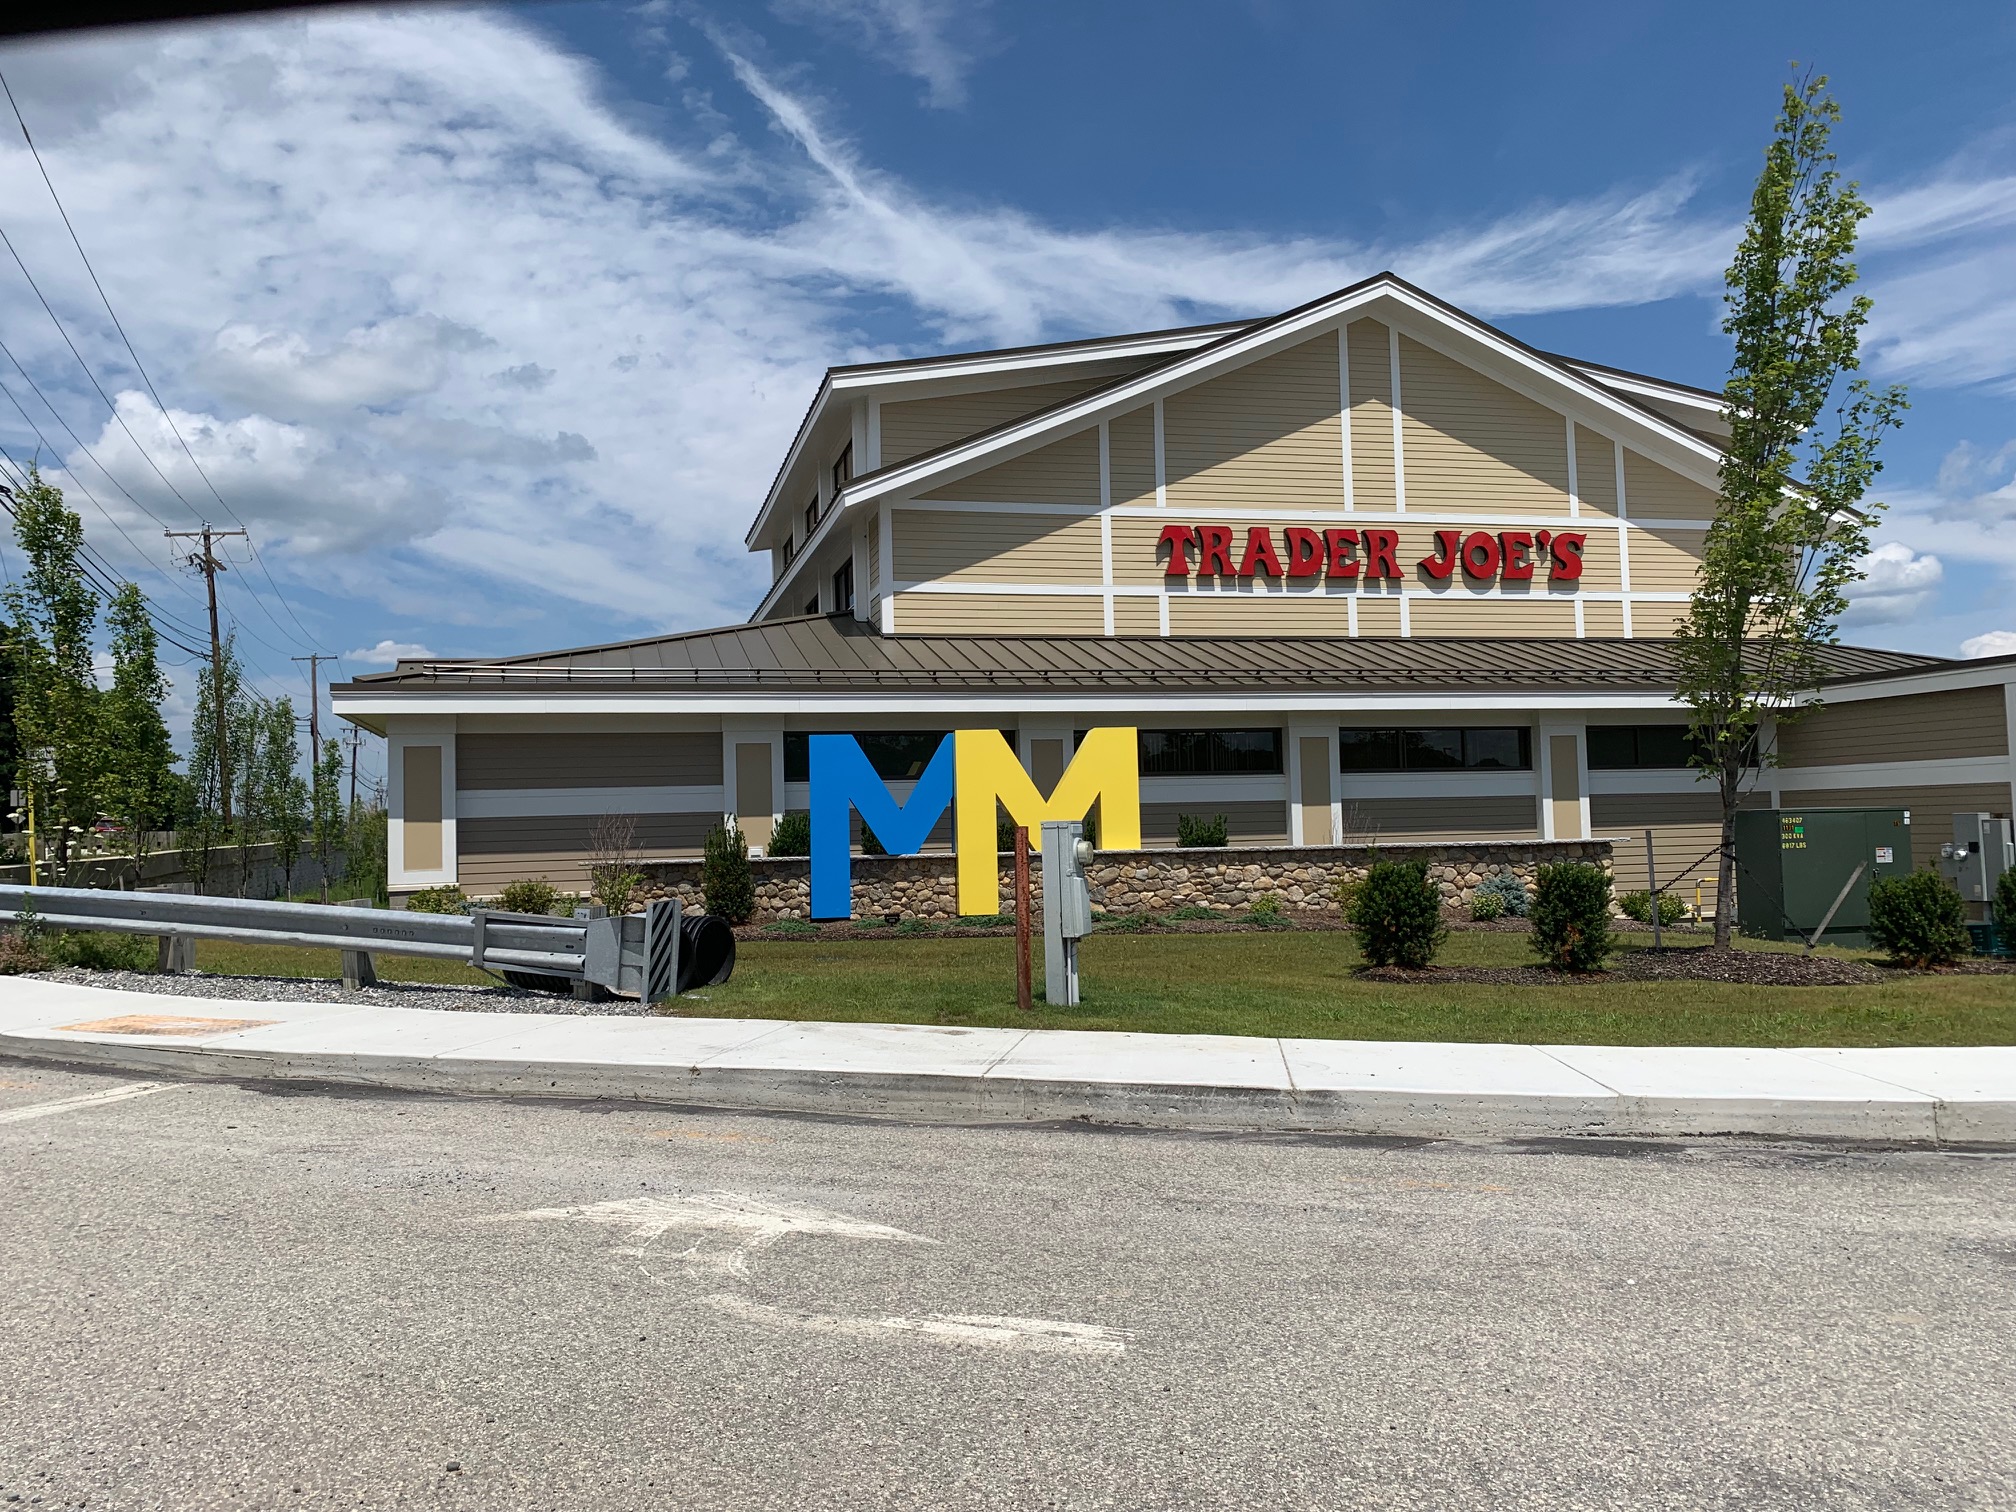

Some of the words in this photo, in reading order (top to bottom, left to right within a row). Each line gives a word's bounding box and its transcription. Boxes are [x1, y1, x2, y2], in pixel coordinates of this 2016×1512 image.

[1157, 524, 1405, 579] TRADER
[1417, 529, 1588, 581] JOE'S
[1795, 841, 1807, 849] LBS
